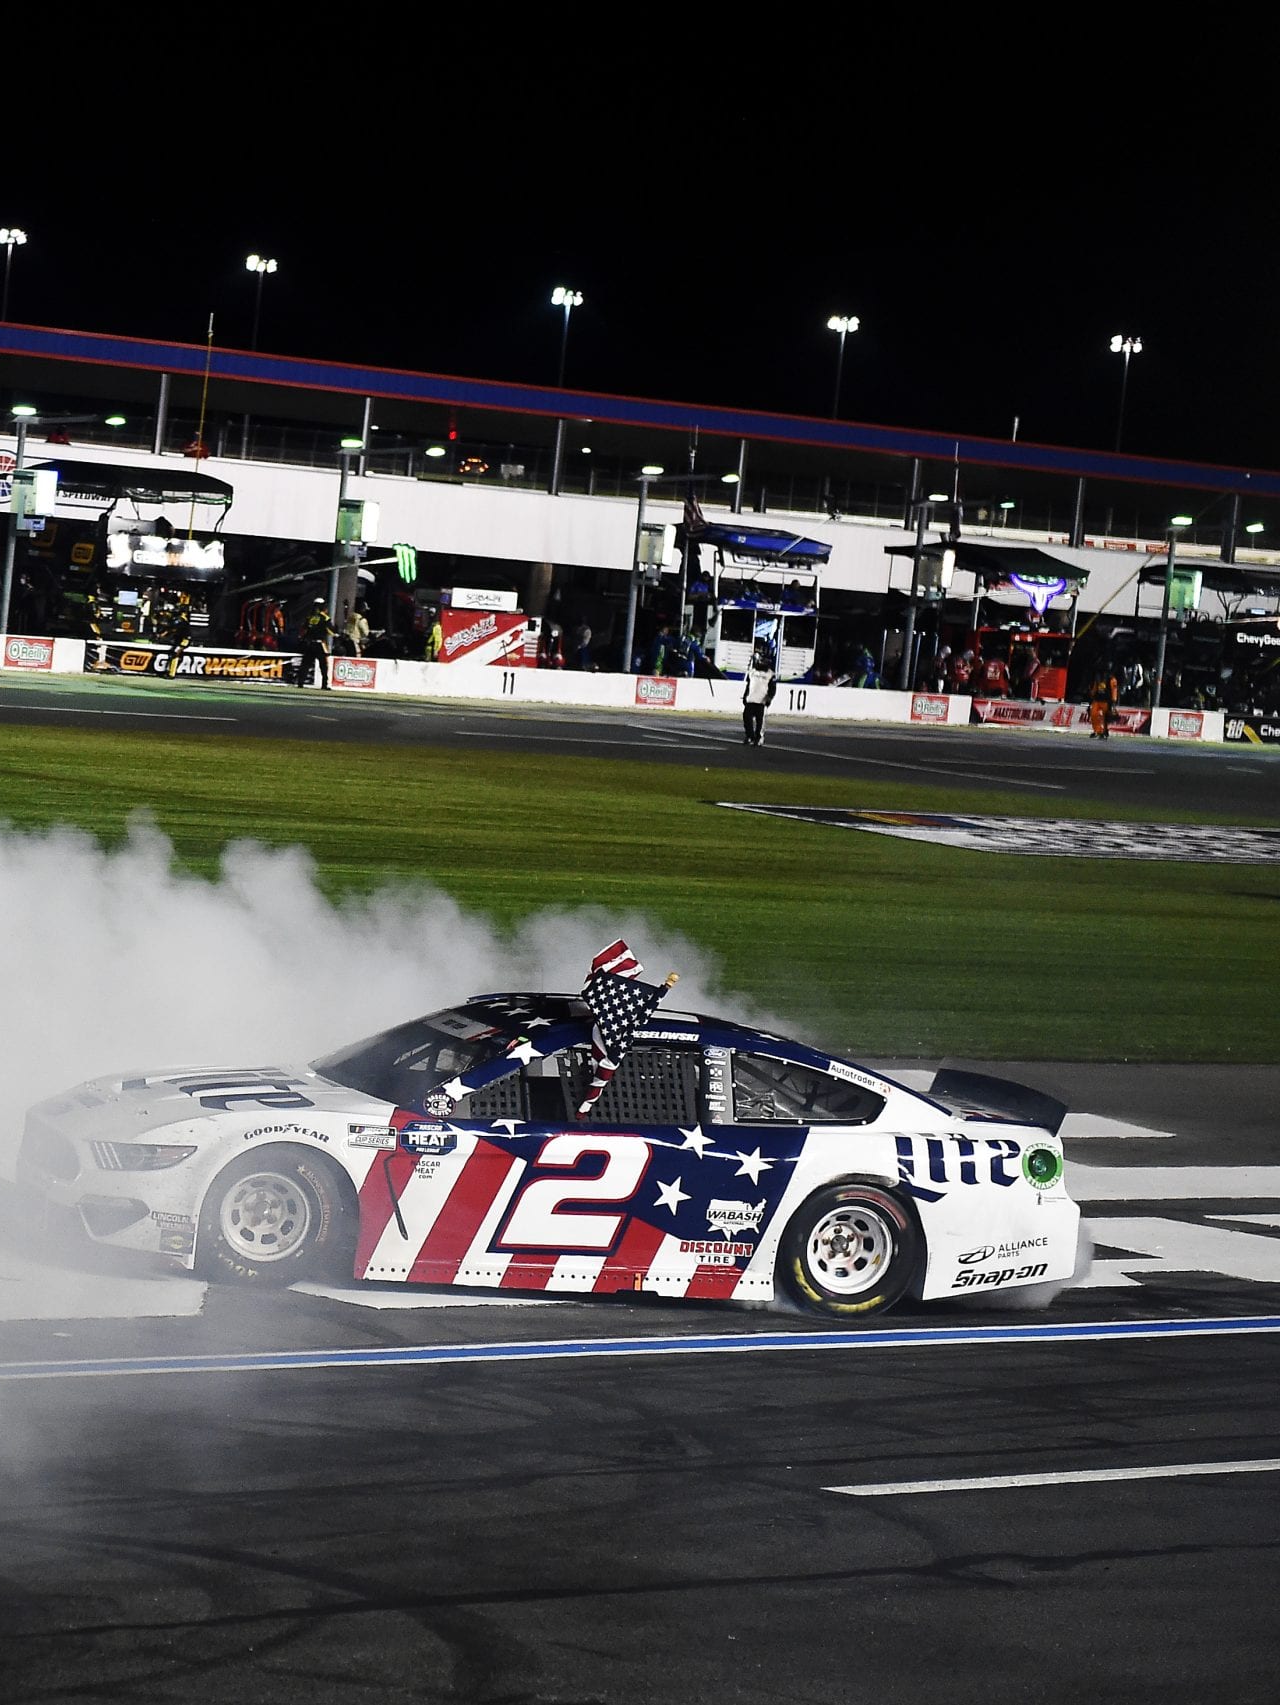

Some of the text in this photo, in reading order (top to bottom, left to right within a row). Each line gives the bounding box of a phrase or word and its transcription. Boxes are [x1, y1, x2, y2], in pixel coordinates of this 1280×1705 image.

[10, 642, 50, 661] O'Reilly
[154, 653, 283, 678] GARWRENCH
[336, 664, 372, 682] O'Reilly
[503, 672, 515, 695] 11
[789, 689, 806, 711] 10
[1050, 706, 1075, 727] 41
[830, 1064, 876, 1087] Autotrader
[244, 1123, 330, 1144] GOODYEAR
[368, 1137, 390, 1145] SERIES
[409, 1133, 447, 1146] HEAT
[895, 1133, 1021, 1203] Lite
[498, 1133, 652, 1252] 2
[708, 1210, 763, 1222] WABASH
[680, 1241, 753, 1256] DISCOUNT
[999, 1237, 1048, 1252] ALLIANCE
[699, 1255, 730, 1264] TIRE
[998, 1251, 1020, 1259] PARTS
[951, 1263, 1048, 1289] Snap-on
